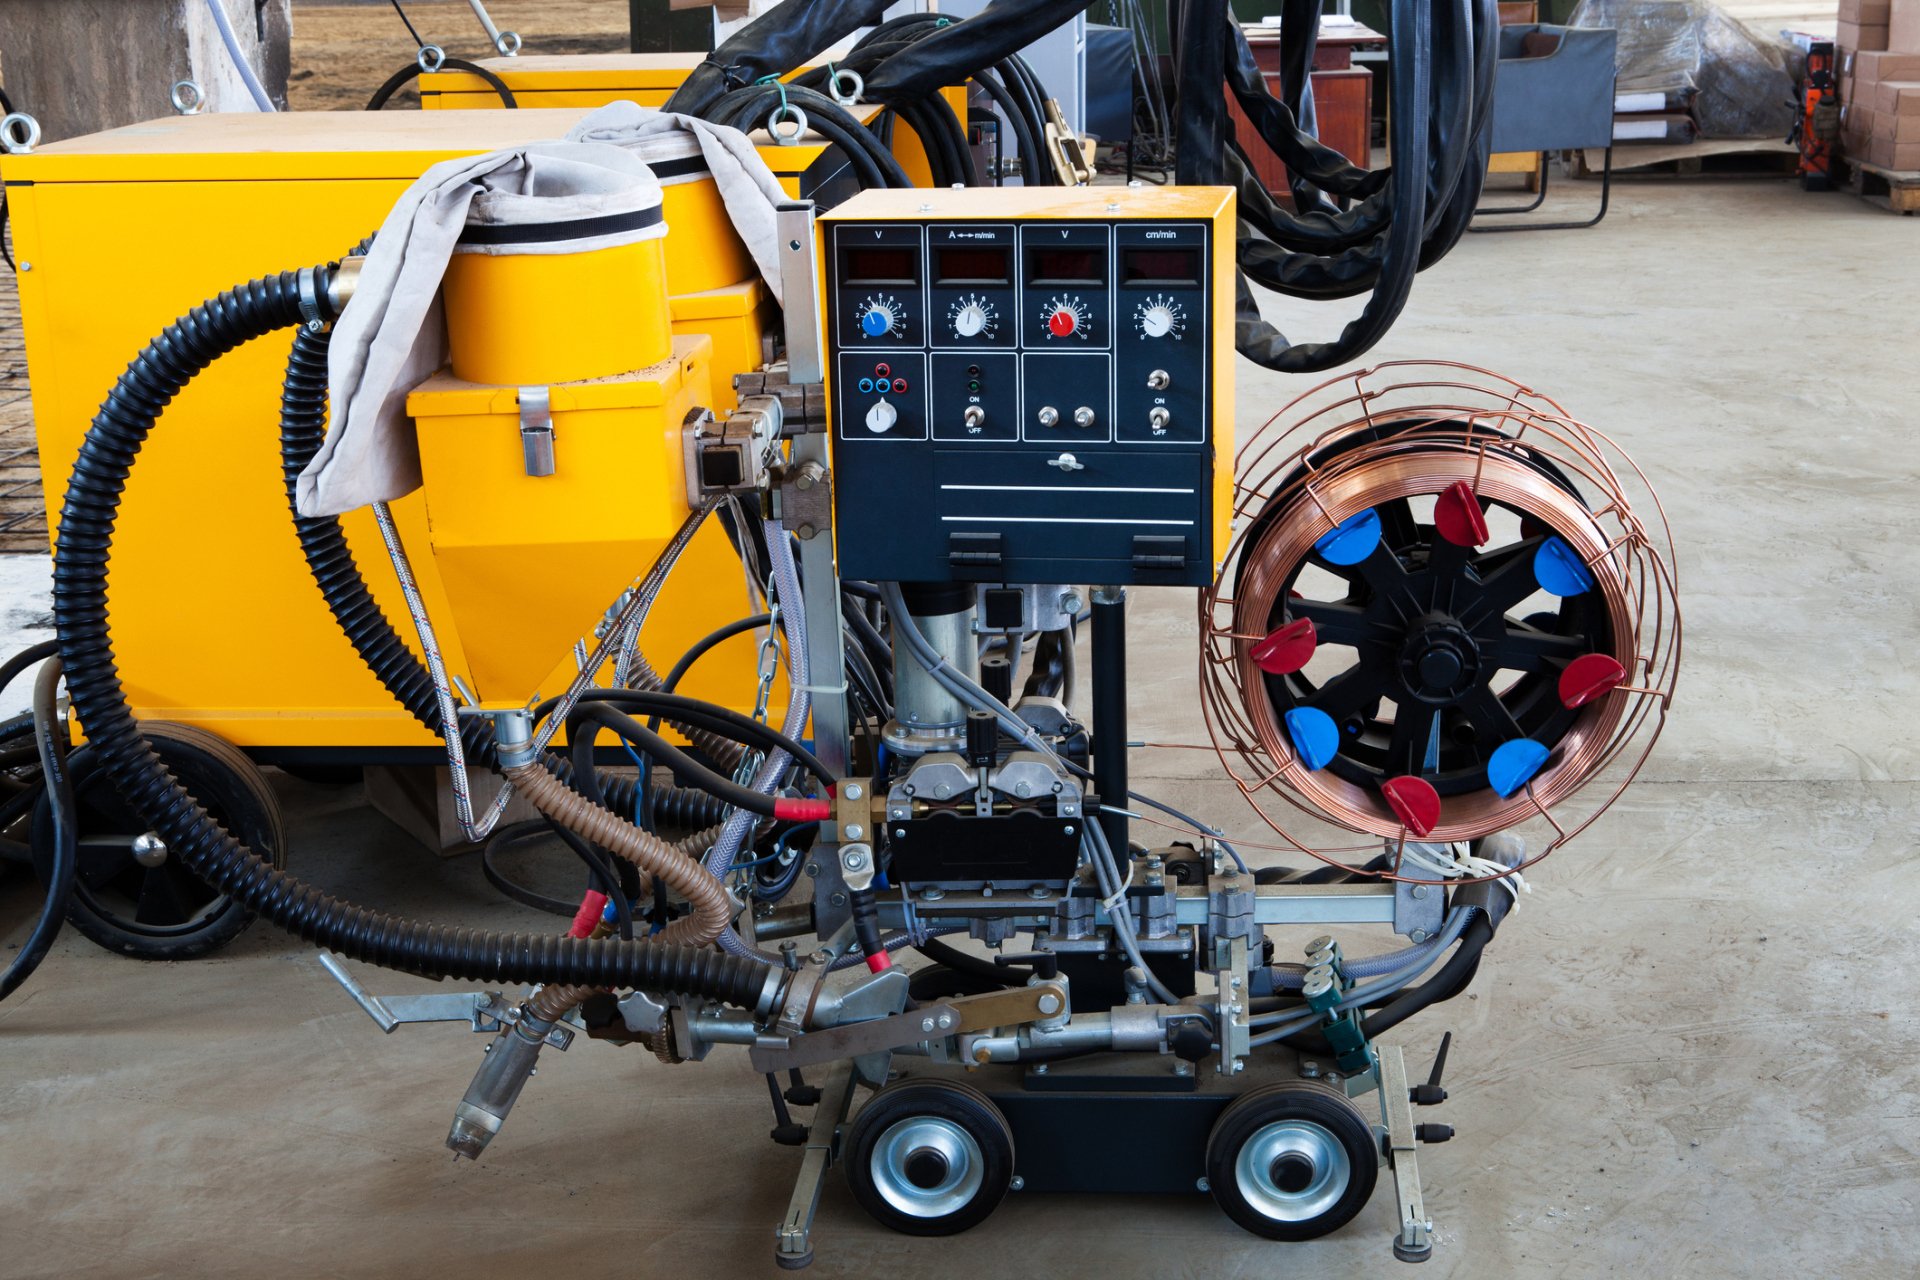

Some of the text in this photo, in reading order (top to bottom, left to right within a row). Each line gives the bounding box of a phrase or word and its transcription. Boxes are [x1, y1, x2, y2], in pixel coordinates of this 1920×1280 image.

[875, 231, 882, 239] V
[948, 230, 956, 239] A
[1061, 230, 1069, 239] V
[1145, 230, 1177, 239] cm/min
